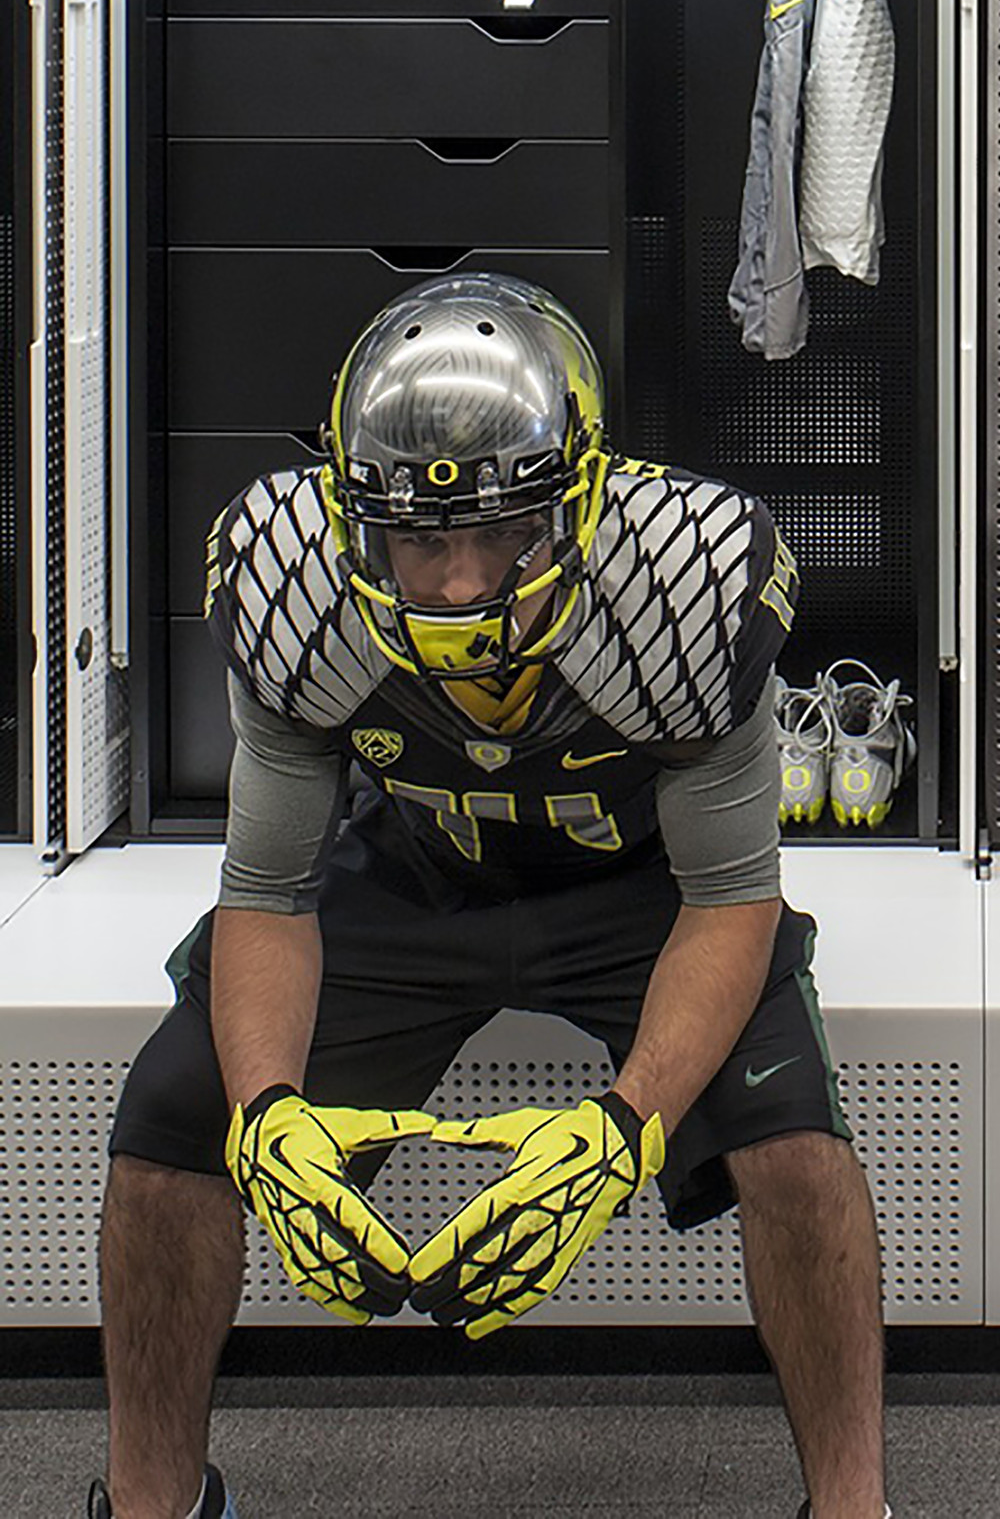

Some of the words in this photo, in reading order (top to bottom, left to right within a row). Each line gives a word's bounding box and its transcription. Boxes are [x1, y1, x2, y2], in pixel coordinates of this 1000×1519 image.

[427, 459, 460, 487] O
[782, 765, 811, 790] O
[842, 768, 871, 794] O
